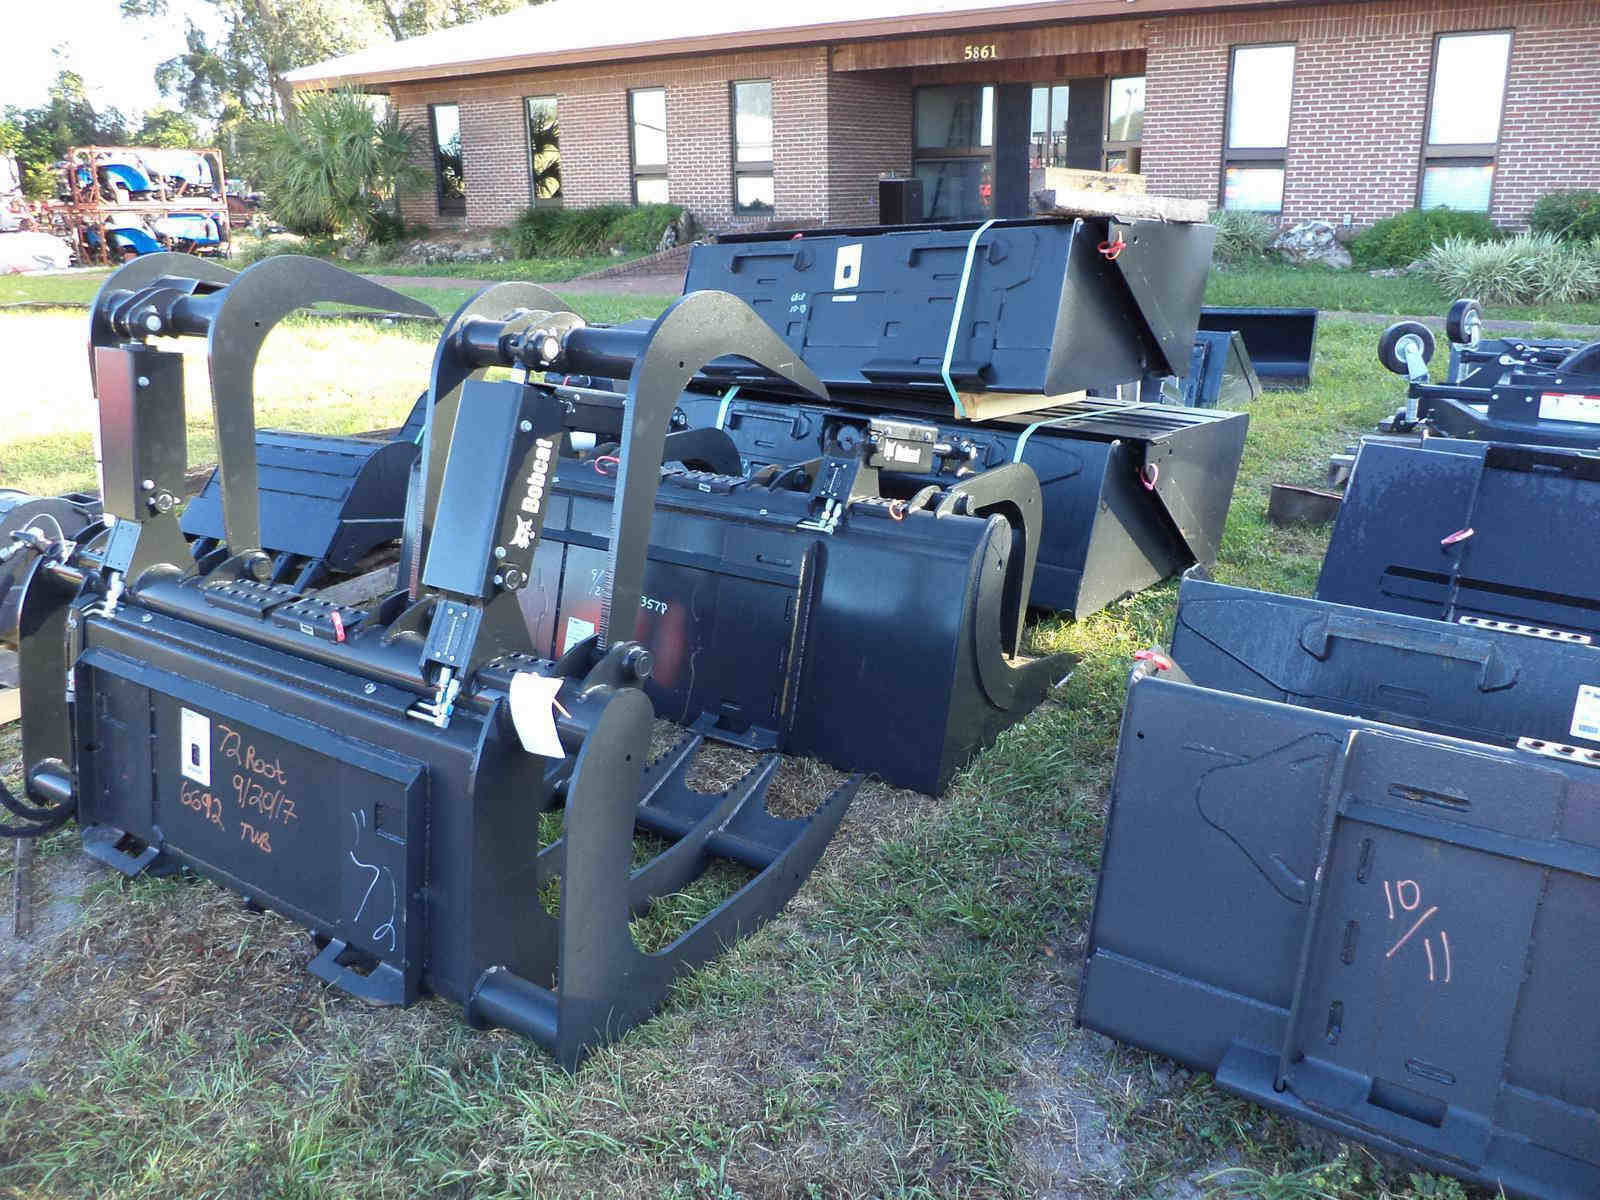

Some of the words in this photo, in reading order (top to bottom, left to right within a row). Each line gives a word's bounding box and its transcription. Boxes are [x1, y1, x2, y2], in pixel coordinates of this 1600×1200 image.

[964, 44, 997, 60] 5861
[521, 438, 554, 514] Bobcat
[217, 724, 243, 766] 72
[245, 745, 288, 785] Root
[232, 774, 298, 825] 9/20/17
